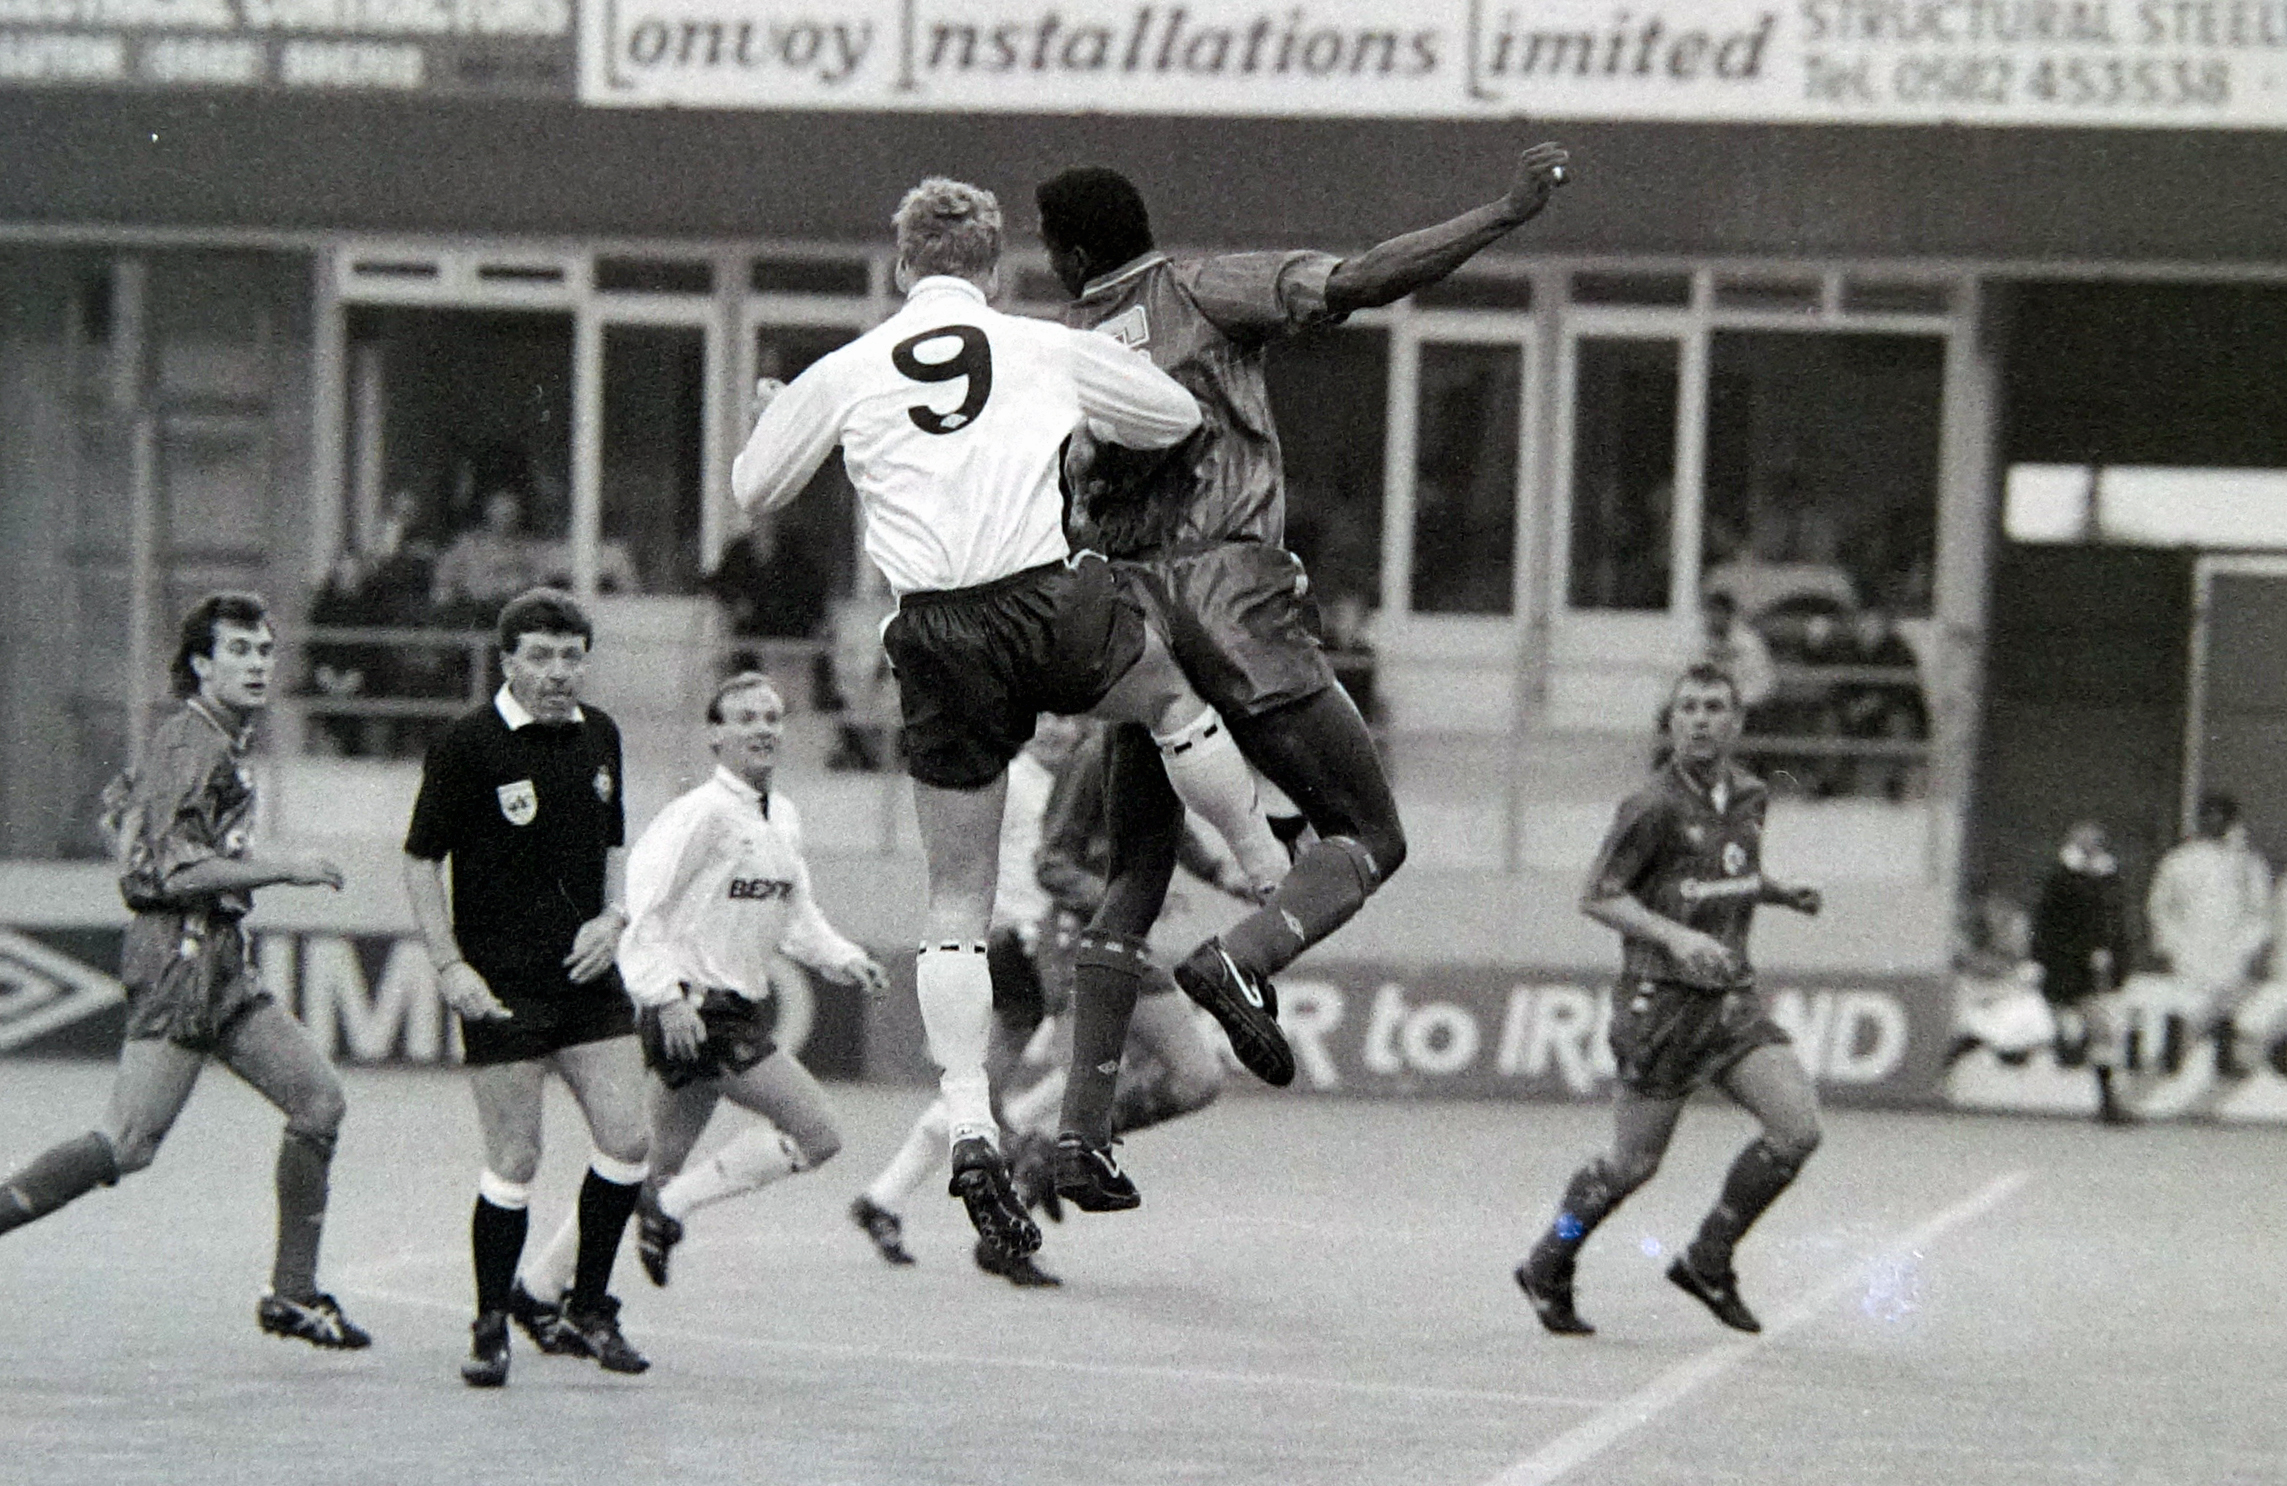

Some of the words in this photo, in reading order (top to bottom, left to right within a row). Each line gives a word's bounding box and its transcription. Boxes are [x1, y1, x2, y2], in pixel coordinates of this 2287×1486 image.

[892, 325, 993, 435] 9
[1362, 984, 1481, 1076] to
[1500, 985, 1909, 1093] IRND
